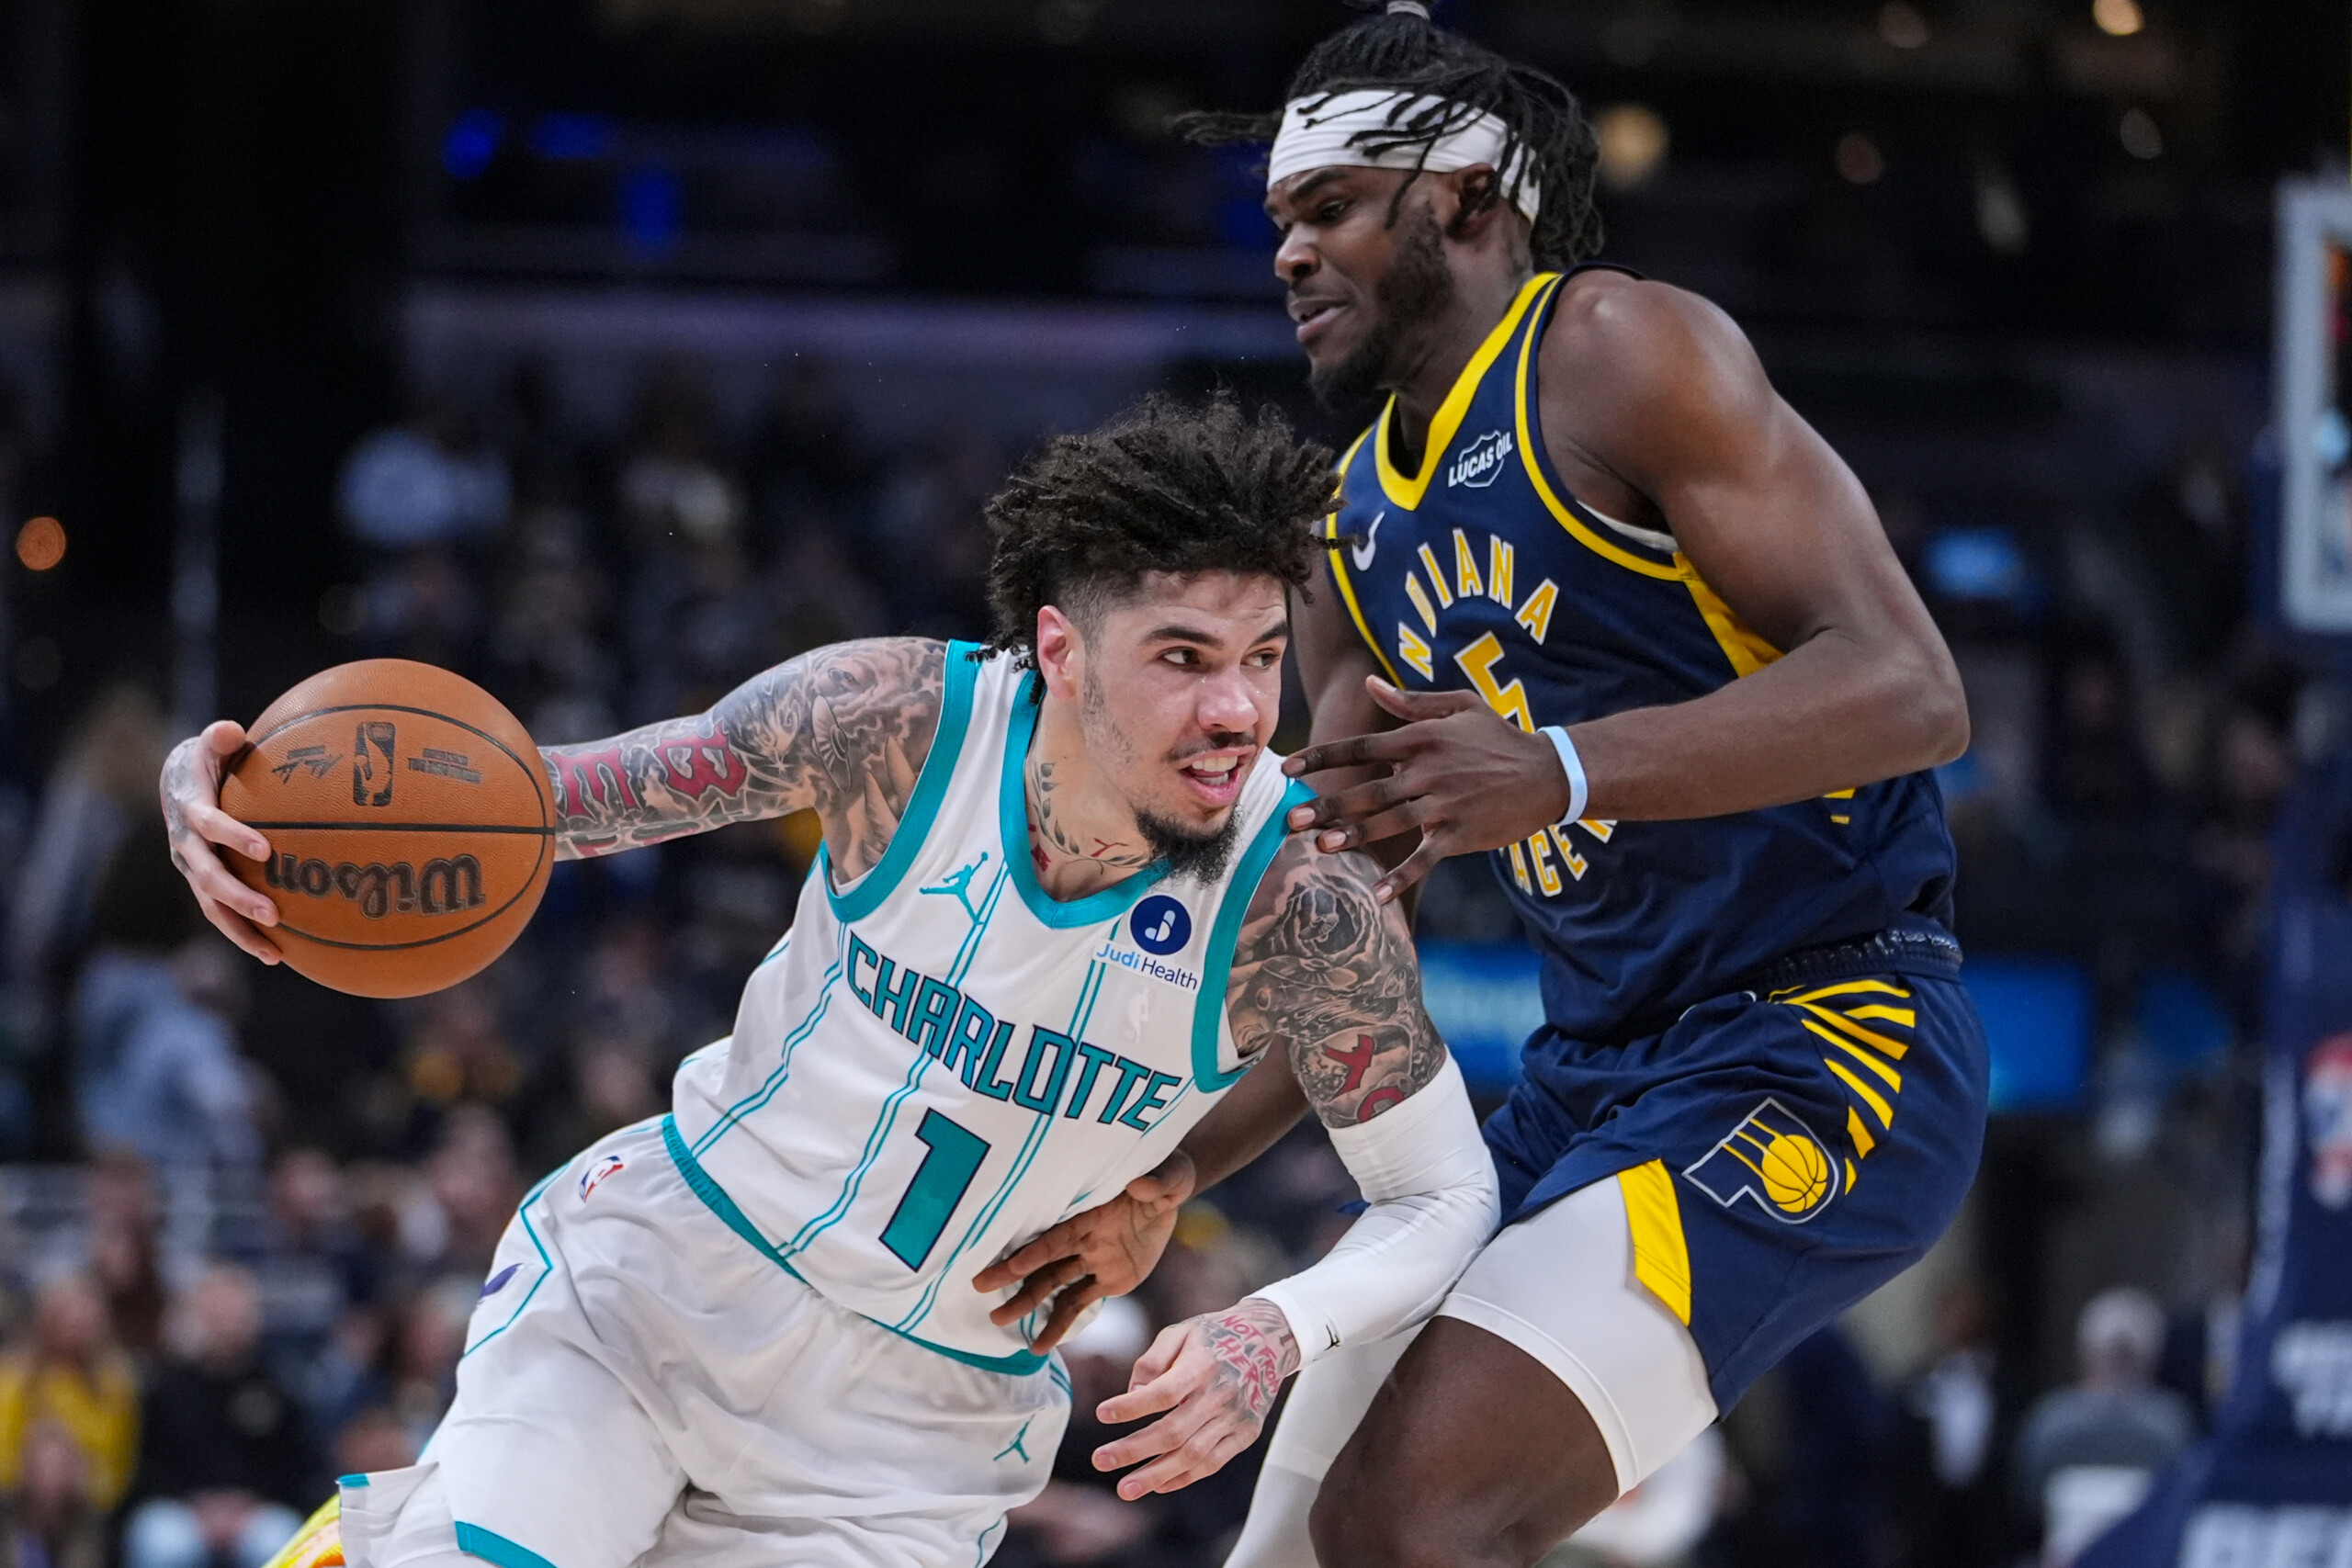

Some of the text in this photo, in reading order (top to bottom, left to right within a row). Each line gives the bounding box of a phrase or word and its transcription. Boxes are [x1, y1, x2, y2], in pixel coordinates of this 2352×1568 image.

[1448, 431, 1513, 487] LUCAS OIL
[1397, 528, 1559, 682] NDIANA
[1453, 630, 1537, 734] 5
[265, 851, 486, 919] Wilson
[1498, 819, 1618, 897] ACE
[1096, 943, 1198, 990] Judi Health
[847, 930, 1182, 1132] CHARLOTTE
[878, 1107, 991, 1273] 1
[1218, 1315, 1265, 1341] NOT
[1216, 1337, 1265, 1412] HERE
